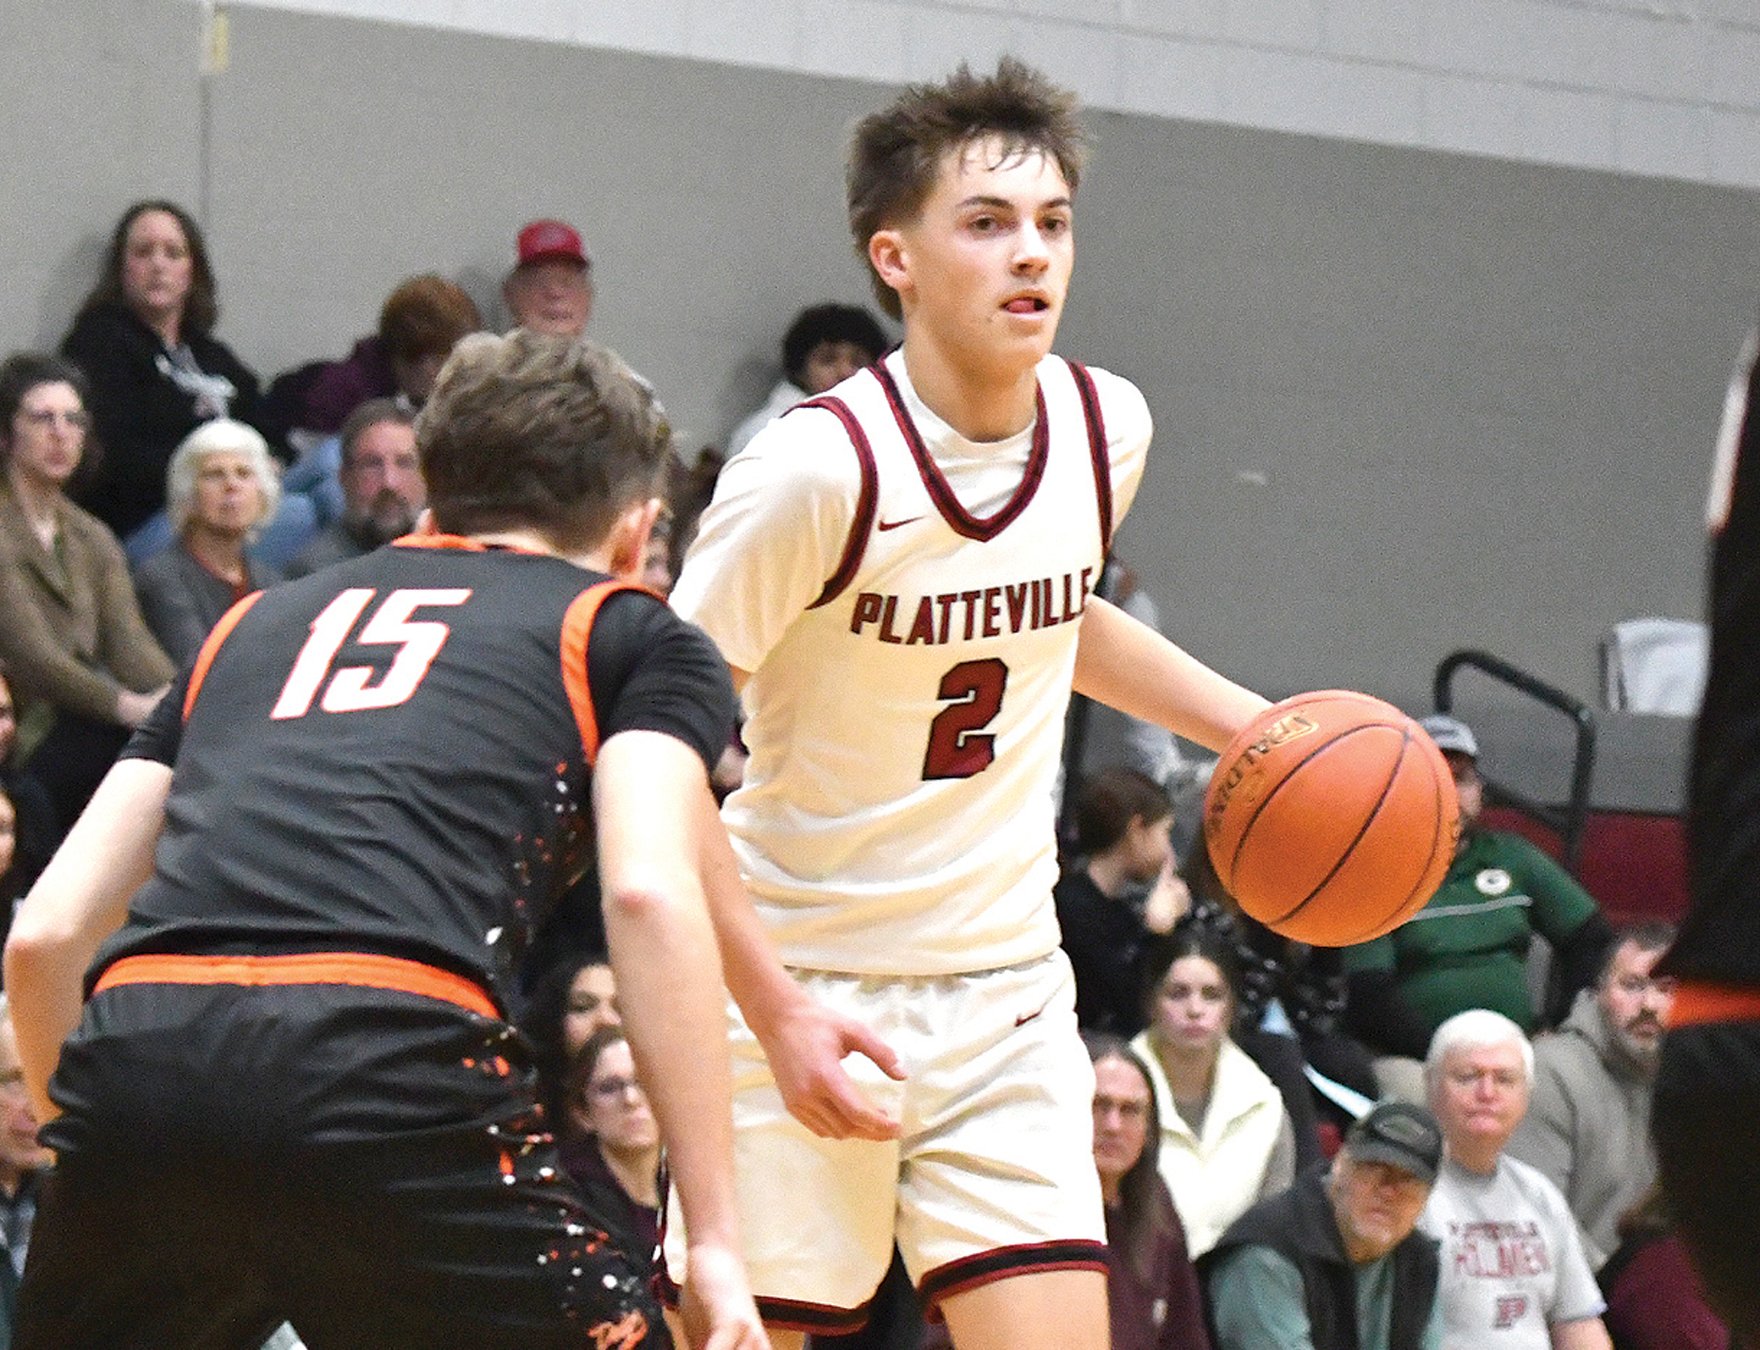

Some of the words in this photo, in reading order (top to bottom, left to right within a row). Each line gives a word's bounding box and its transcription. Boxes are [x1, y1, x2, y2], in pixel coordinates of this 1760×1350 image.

[269, 587, 474, 720] 15
[850, 566, 1093, 645] PLATTEVILLE
[922, 657, 1009, 781] 2
